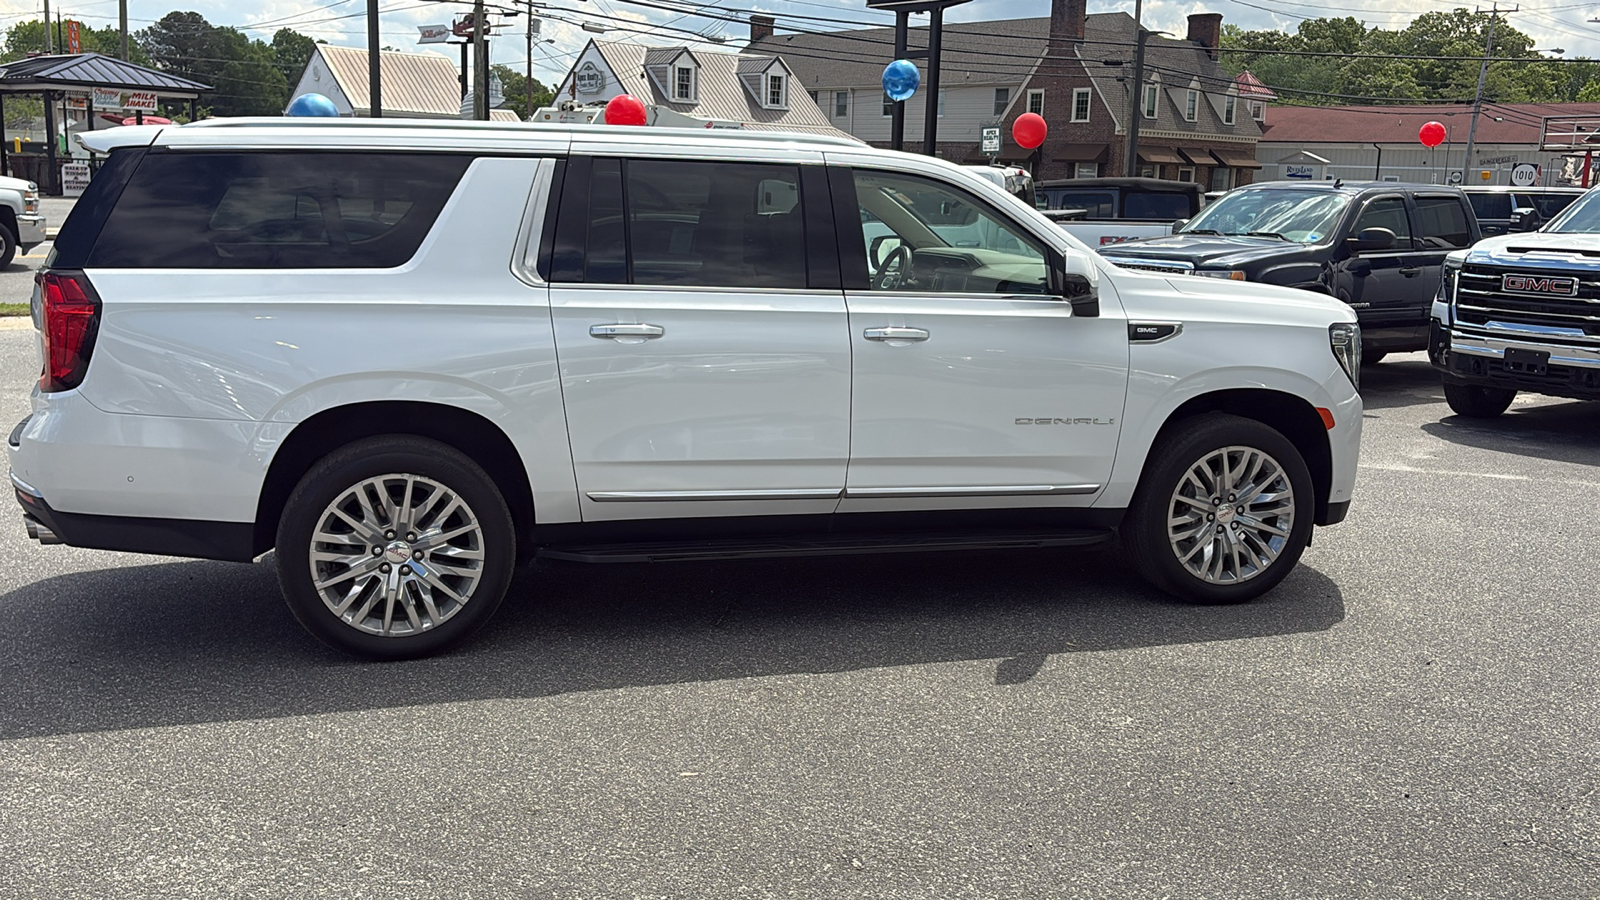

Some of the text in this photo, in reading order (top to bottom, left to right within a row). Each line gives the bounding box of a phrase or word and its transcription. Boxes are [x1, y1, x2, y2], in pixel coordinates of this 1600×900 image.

[126, 100, 156, 108] SHAKES
[1515, 170, 1534, 180] 1010
[1506, 277, 1572, 293] GMC
